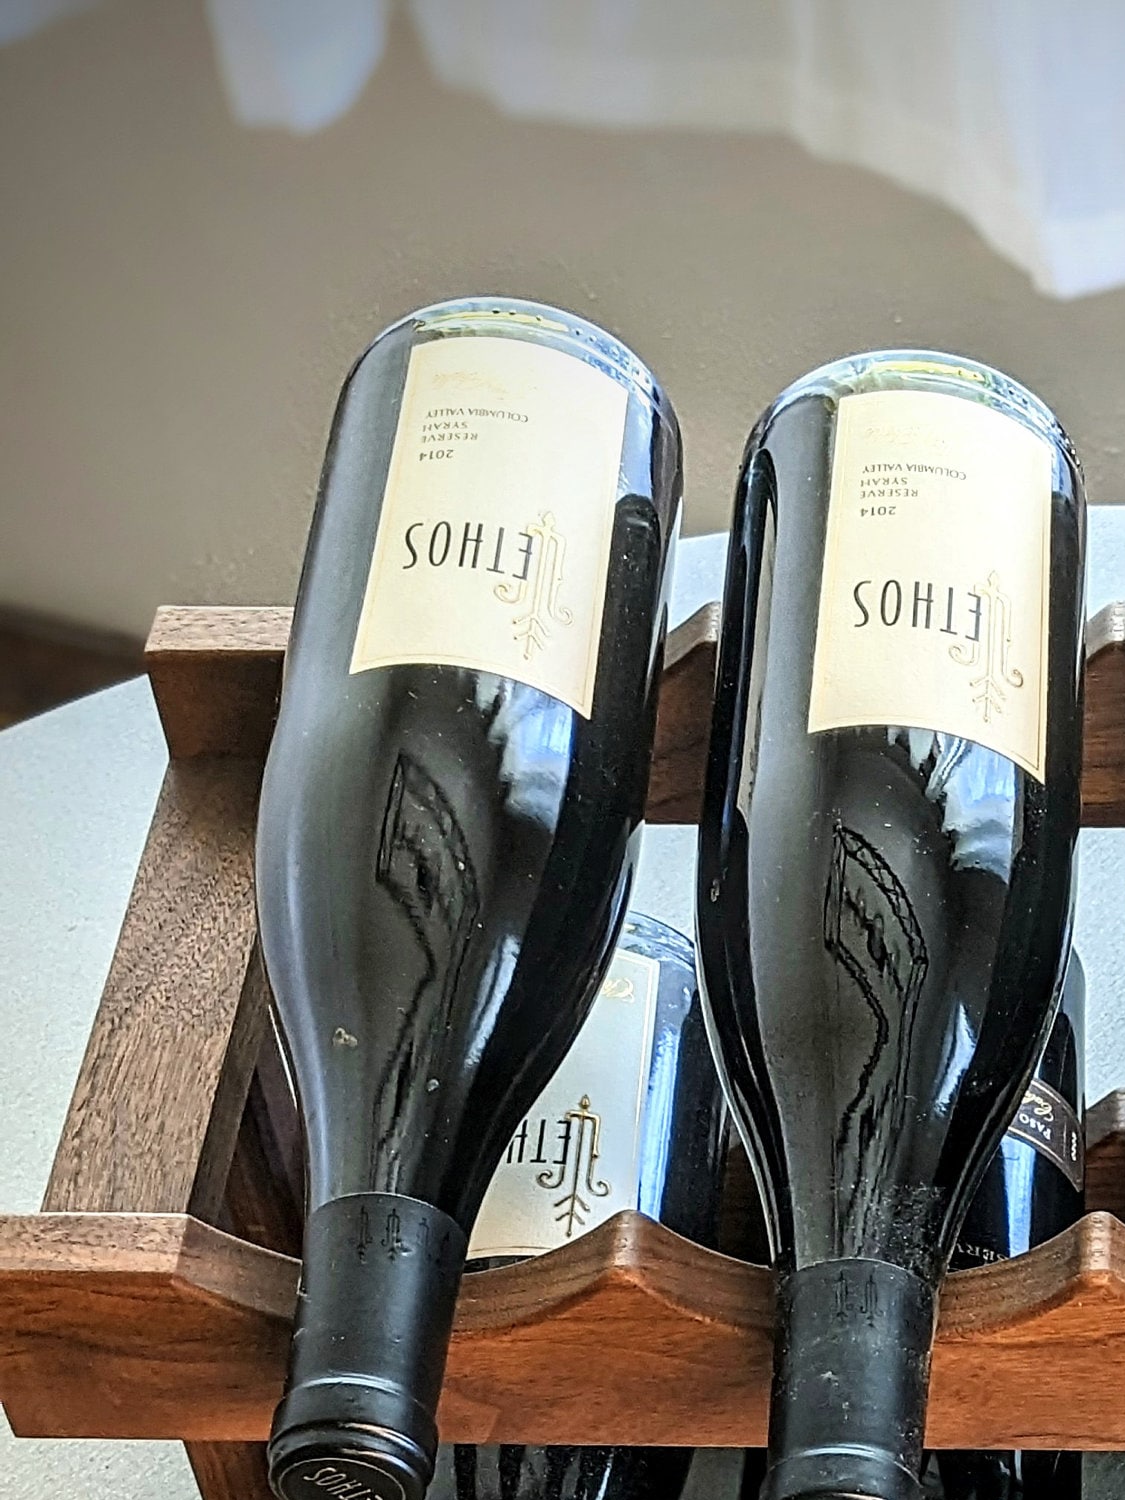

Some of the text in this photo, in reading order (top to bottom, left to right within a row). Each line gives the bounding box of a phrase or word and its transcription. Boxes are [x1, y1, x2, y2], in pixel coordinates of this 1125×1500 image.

[426, 407, 529, 423] COLUMBIA VALLEY
[423, 421, 468, 432] SYRAH
[421, 432, 478, 444] RESERVE
[419, 450, 454, 461] 2014
[862, 463, 967, 481] COLUMBIA VALLEY
[860, 477, 908, 487] SYRAH
[859, 489, 919, 499] RESERVE
[860, 505, 897, 517] 2014
[402, 521, 533, 581] ETHOS
[853, 579, 982, 642] ETHOS
[1019, 1113, 1052, 1140] PASO
[506, 1119, 571, 1165] ETH
